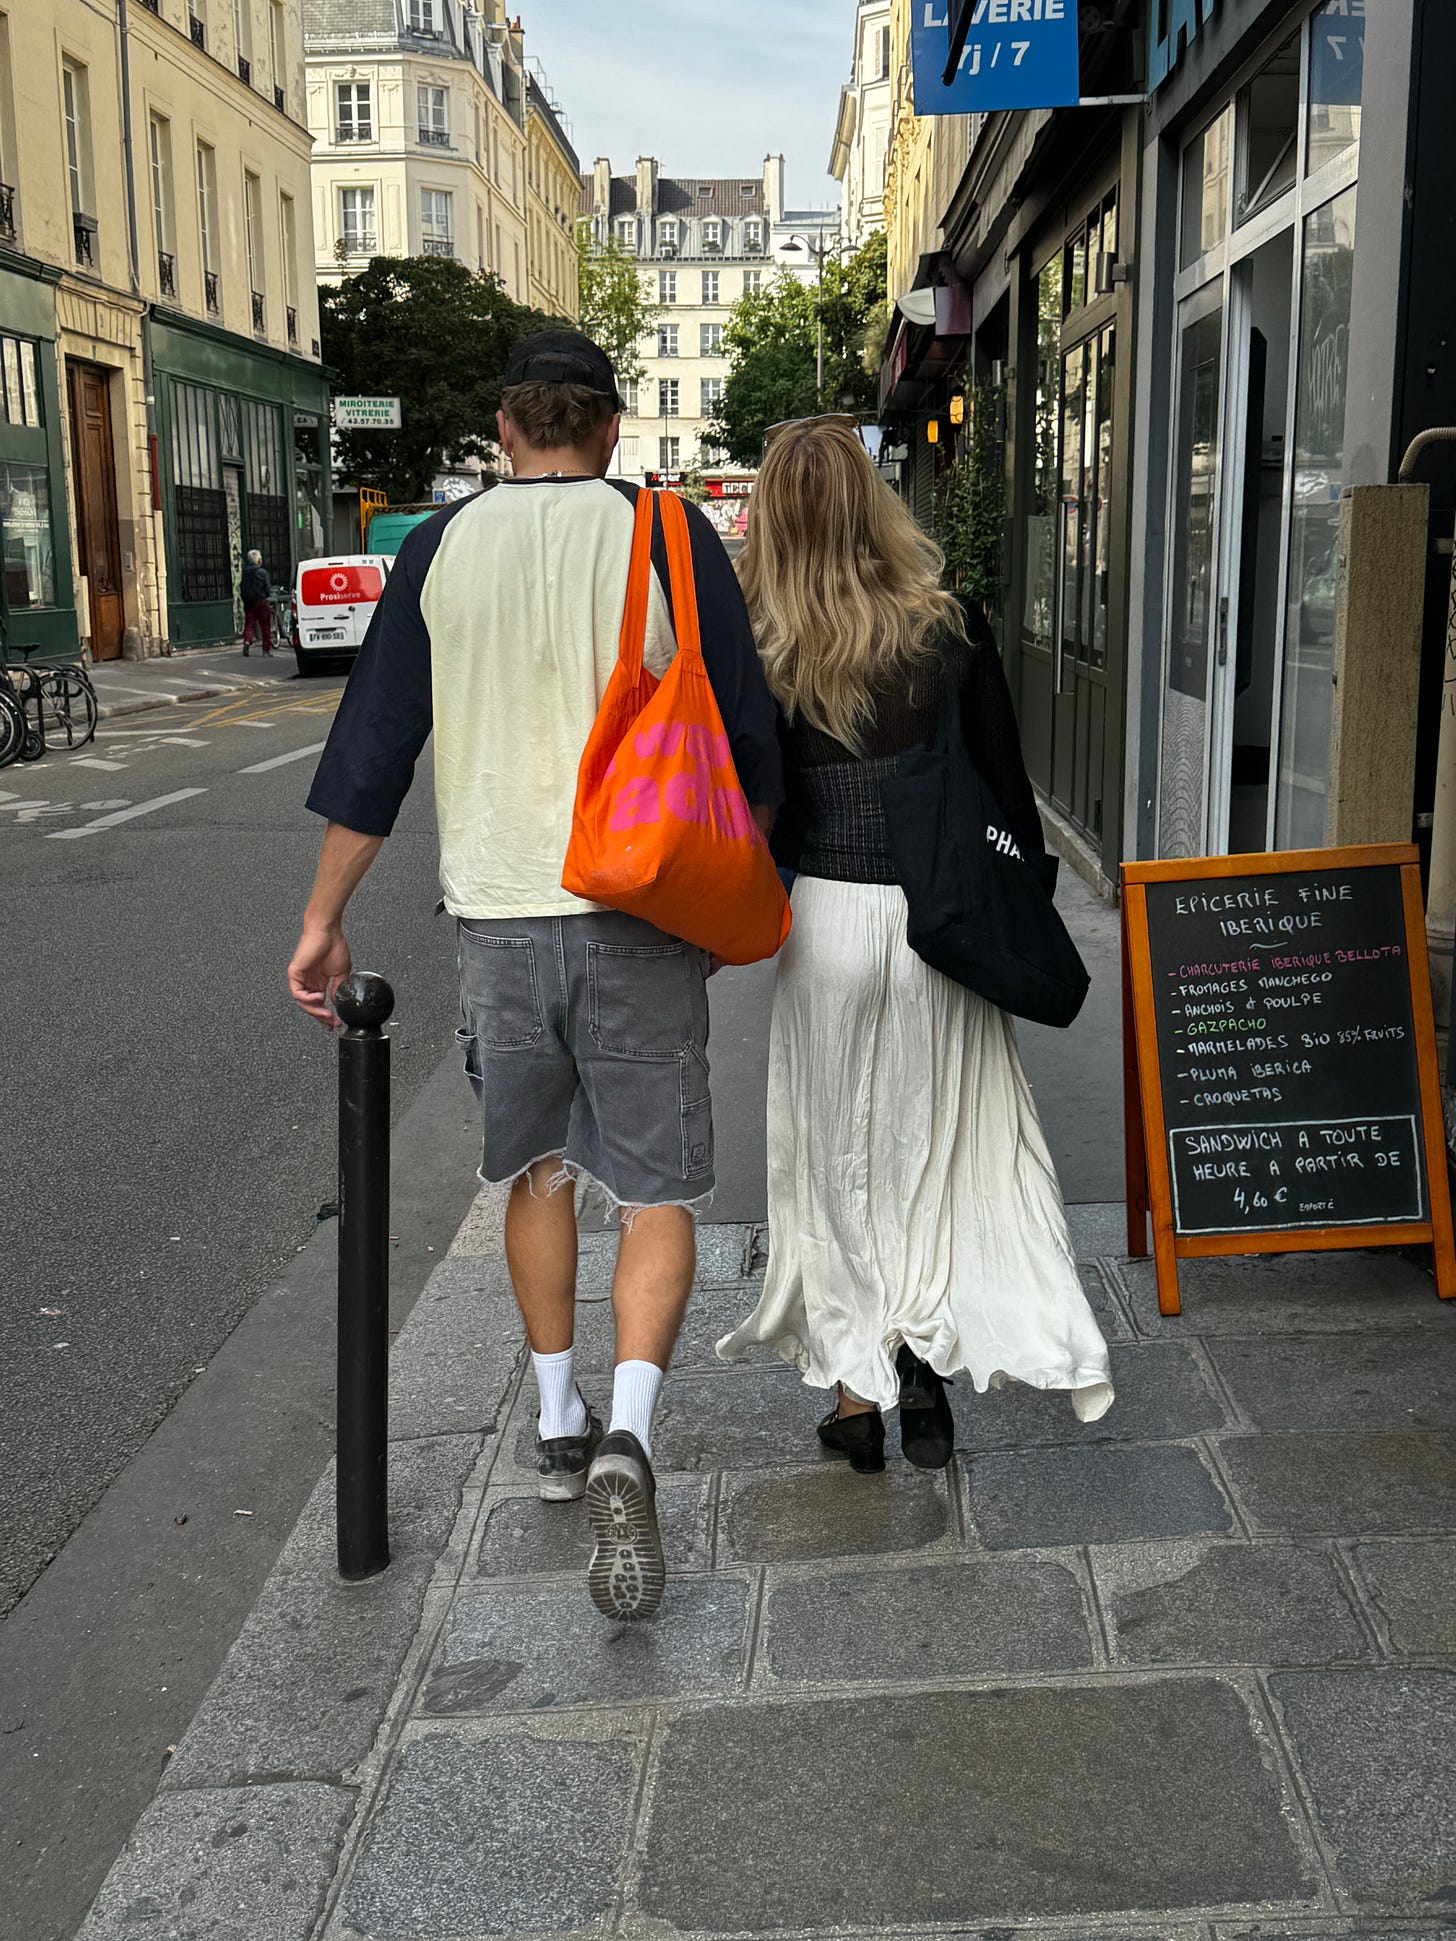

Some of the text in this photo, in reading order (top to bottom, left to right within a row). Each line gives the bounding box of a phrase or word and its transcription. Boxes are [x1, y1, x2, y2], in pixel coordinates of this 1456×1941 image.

[923, 0, 1064, 28] LVERIE
[1011, 41, 1030, 66] 7
[339, 400, 394, 408] MIROITERIE
[346, 409, 390, 417] VITRERIE
[1176, 883, 1353, 914] EPICERIE FINE
[1220, 911, 1323, 936] IBERIQUE
[1335, 946, 1401, 963] BELLOTA
[1258, 972, 1332, 988] MANCHEGO
[1264, 992, 1322, 1010] POULPE
[1185, 1126, 1381, 1156] SANDWICH A TOUTE
[1193, 1151, 1400, 1180] HEURE A PARTIR DE
